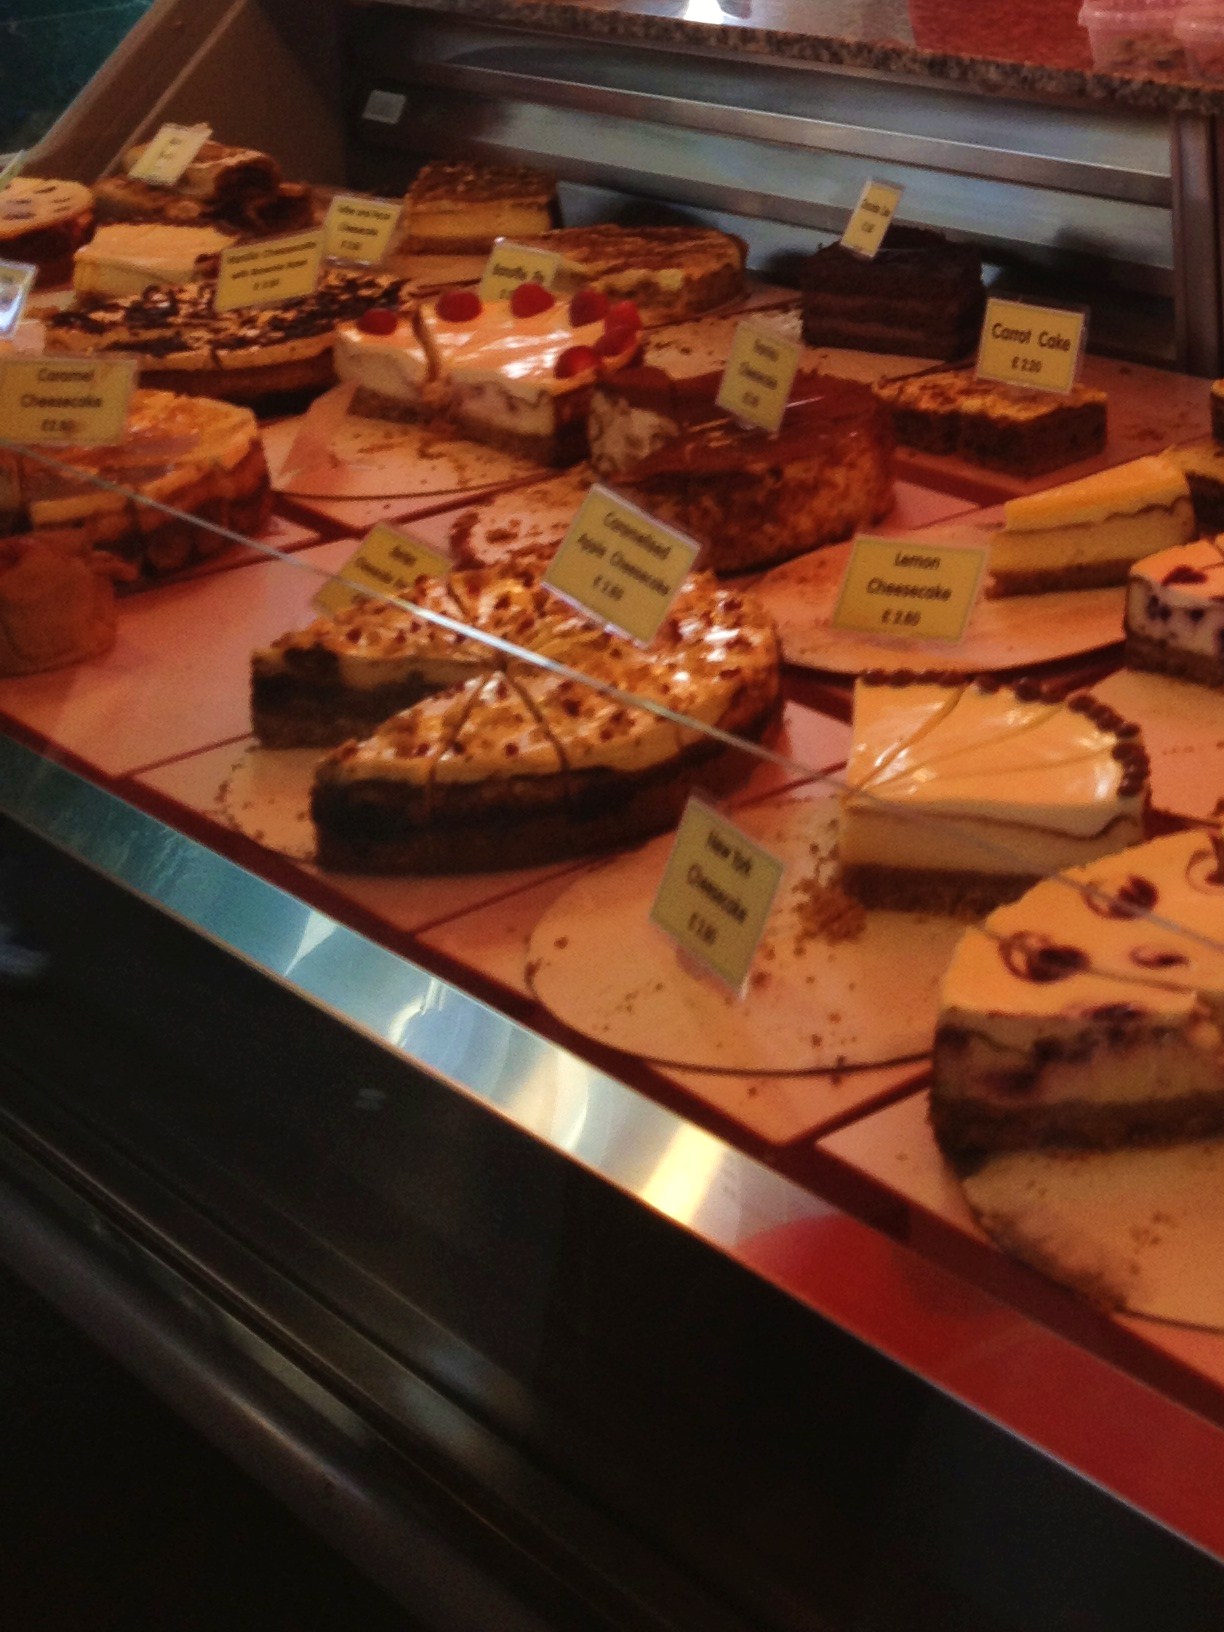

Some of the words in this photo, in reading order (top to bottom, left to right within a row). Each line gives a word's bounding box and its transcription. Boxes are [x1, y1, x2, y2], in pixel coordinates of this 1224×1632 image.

[991, 322, 1032, 345] Carrot
[1038, 330, 1072, 352] Cake
[20, 393, 103, 409] Cheesecake
[610, 549, 672, 597] Cheesecake
[894, 551, 942, 571] Lemon
[866, 576, 952, 602] Cheesecake
[687, 863, 748, 925] Cheesecake
